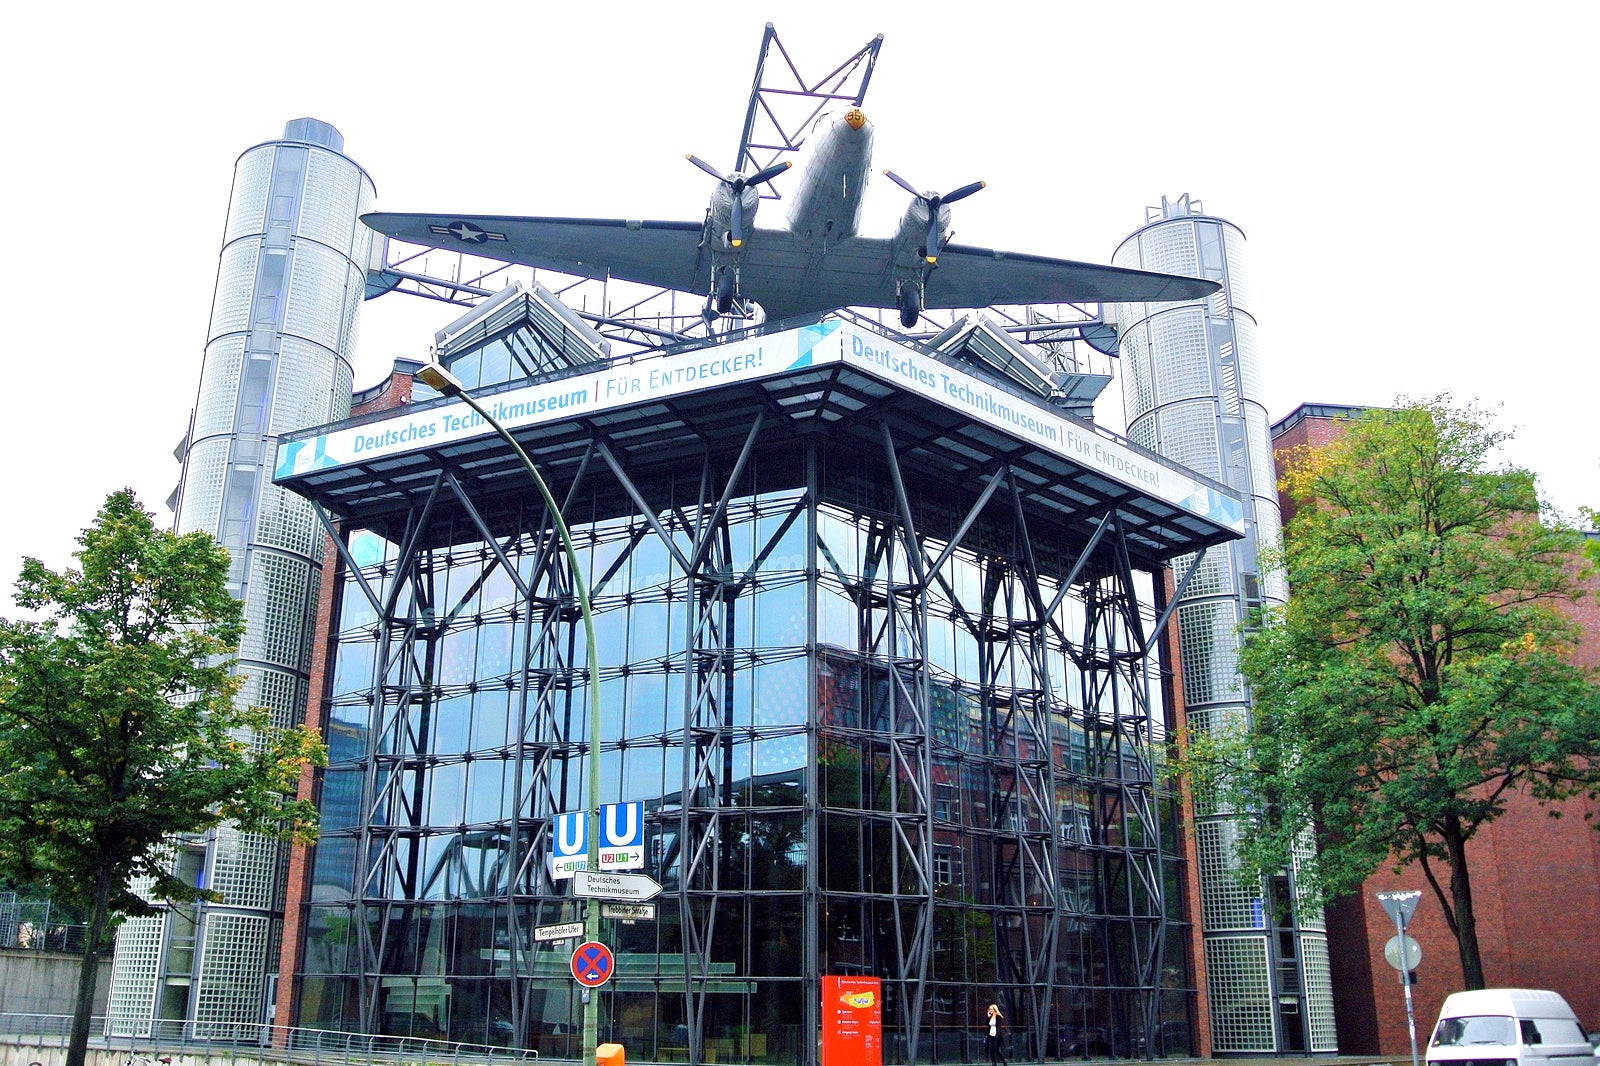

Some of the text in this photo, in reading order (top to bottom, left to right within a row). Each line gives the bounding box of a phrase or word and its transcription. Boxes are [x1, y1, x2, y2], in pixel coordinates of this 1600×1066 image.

[353, 422, 436, 453] Deutsches
[605, 376, 641, 398] FÜR
[649, 347, 763, 390] ENTDECKER!
[852, 334, 1160, 488] Deutsches Technikmuseum FÜR ENTDECKER!
[558, 812, 584, 856] U
[606, 802, 637, 847] U
[576, 862, 585, 870] U7
[602, 854, 628, 863] U2 U1
[587, 875, 621, 885] Deutsches
[587, 884, 640, 895] Technikmuseum
